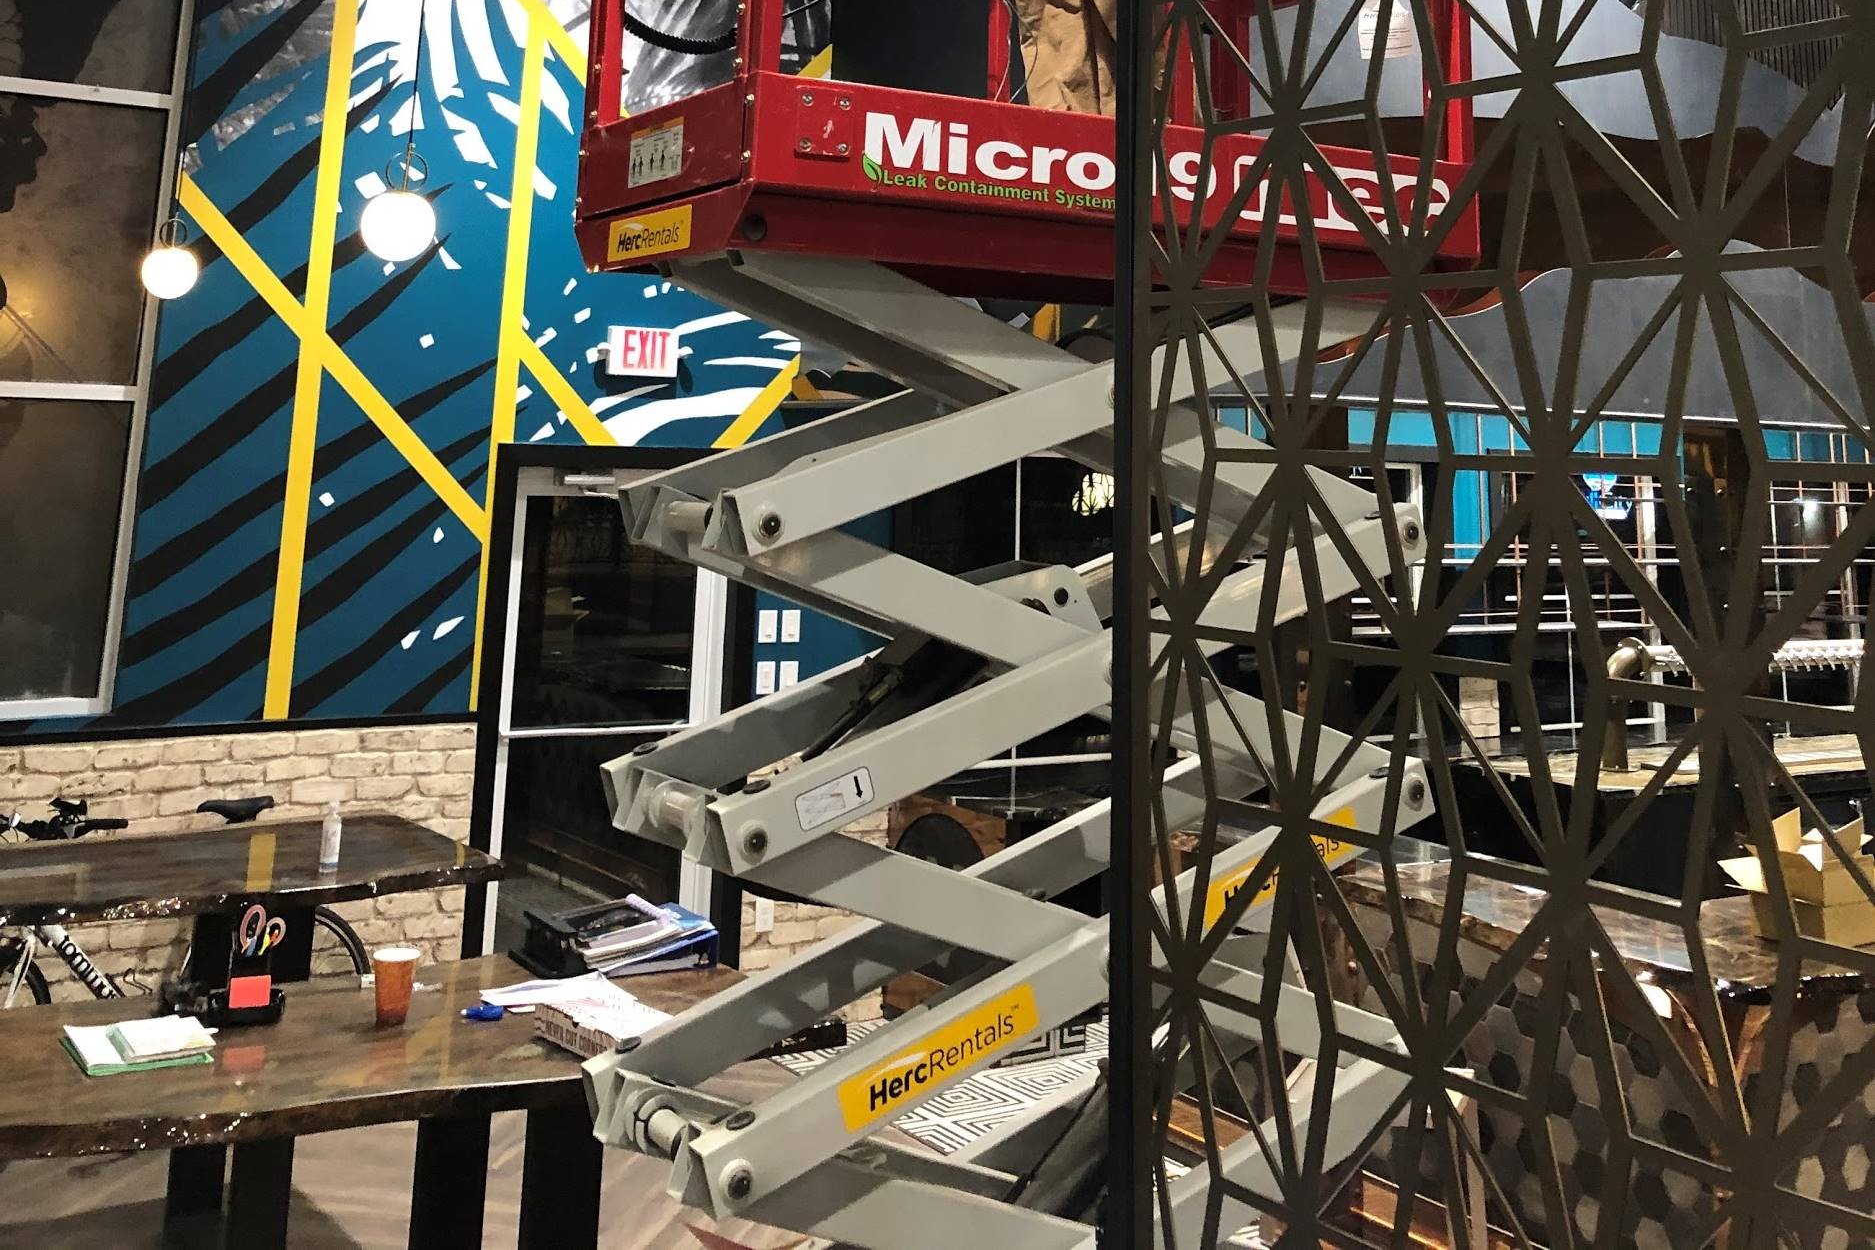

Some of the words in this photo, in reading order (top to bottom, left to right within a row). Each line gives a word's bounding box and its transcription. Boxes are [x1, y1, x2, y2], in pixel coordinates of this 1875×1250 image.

[864, 111, 1117, 191] Micro
[882, 171, 928, 189] Leak
[934, 175, 1050, 202] Containment
[622, 329, 671, 369] EXIT
